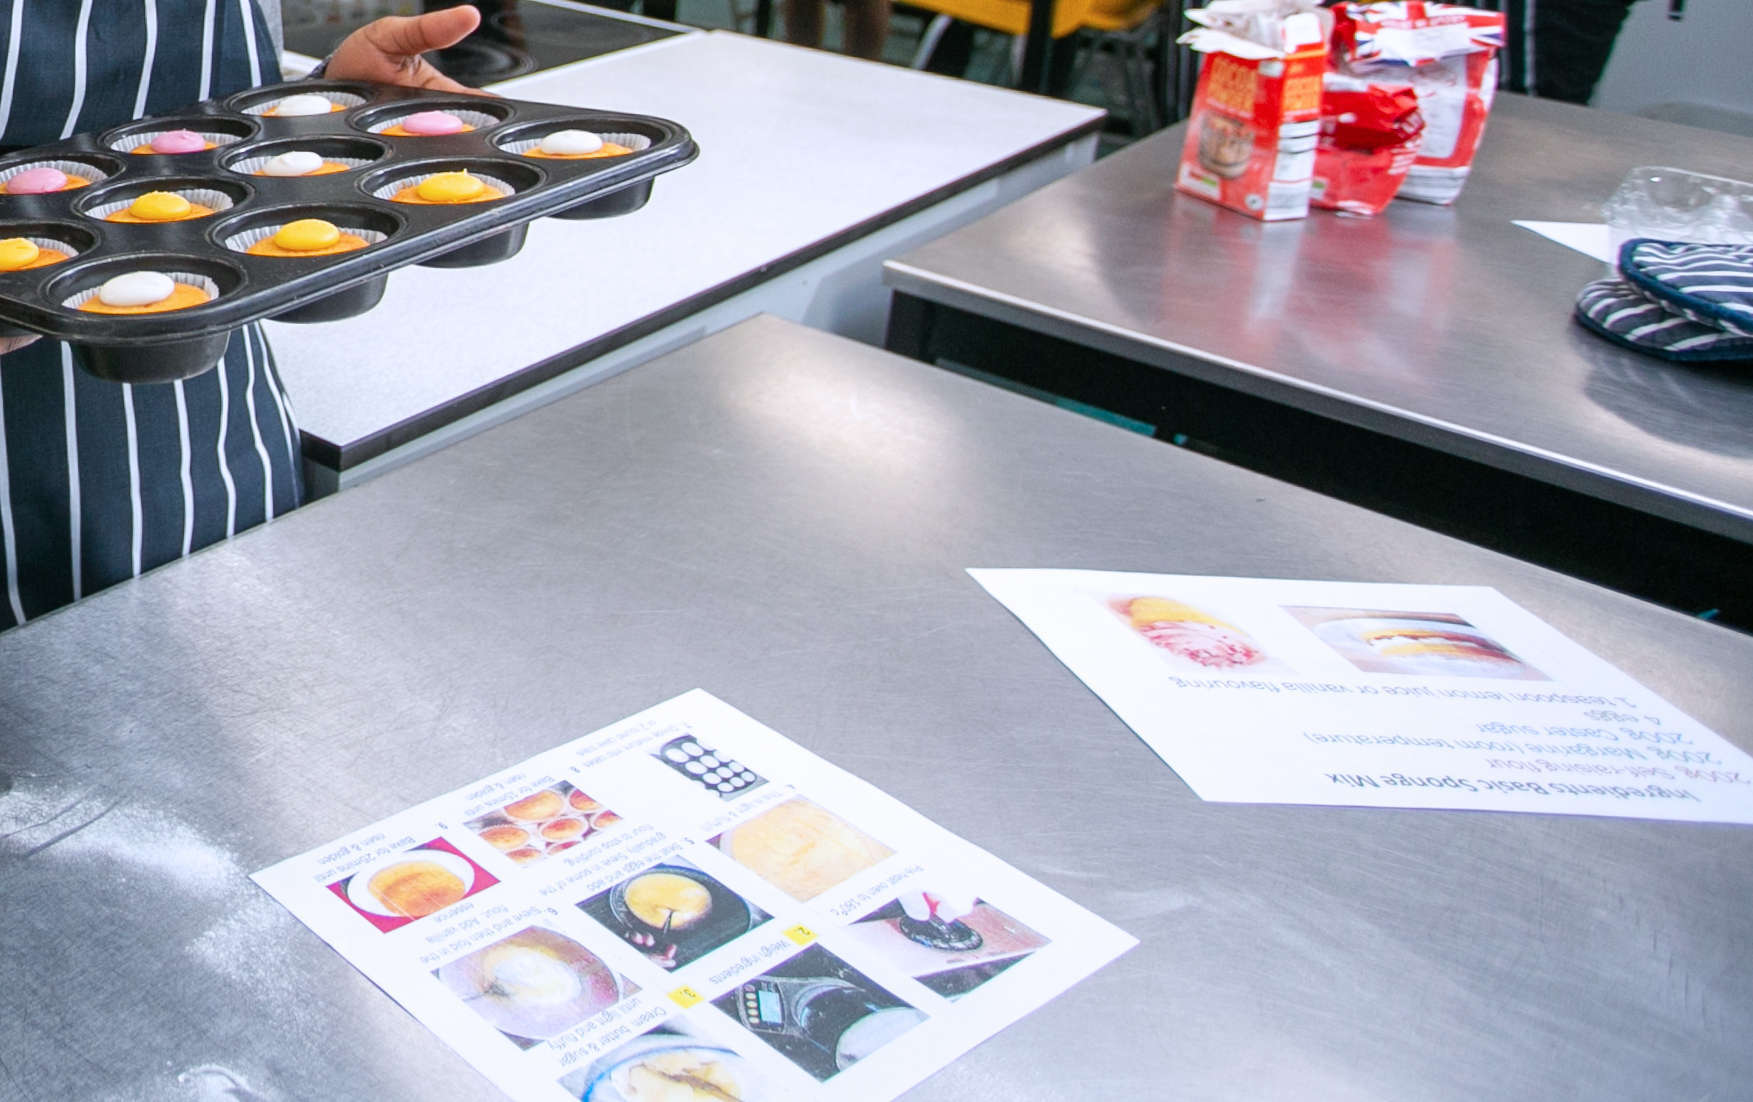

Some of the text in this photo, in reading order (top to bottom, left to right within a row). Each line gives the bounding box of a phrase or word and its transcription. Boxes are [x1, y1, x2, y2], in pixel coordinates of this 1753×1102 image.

[1168, 676, 1636, 709] 1 teaspoon lemon juice or vanilla flavouring
[1583, 710, 1661, 726] 4 eggs
[1475, 722, 1693, 745] 200g Caster sugar
[1303, 731, 1722, 765] 200g Margarine (room temperature)
[1485, 758, 1751, 784] 200g Self-raising flour
[502, 773, 526, 785] risen
[529, 775, 555, 789] Bake
[464, 784, 495, 801] golden
[1324, 773, 1701, 802] Ingredients Basic Sponge Mix
[484, 791, 519, 807] 15mins
[463, 804, 485, 818] until
[735, 803, 757, 814] light
[630, 824, 653, 838] flour
[359, 833, 386, 847] risen
[388, 836, 416, 850] Bake
[600, 837, 622, 851] stop
[316, 846, 351, 866] golden
[374, 846, 391, 857] for
[563, 846, 599, 868] curdling
[658, 843, 683, 856] Beat
[336, 853, 376, 873] 25mins
[601, 852, 628, 868] Sieve
[643, 852, 662, 864] the
[622, 860, 646, 874] eggs
[313, 869, 337, 883] until
[565, 868, 593, 884] some
[604, 870, 624, 882] and
[538, 885, 558, 898] the
[555, 880, 567, 891] of
[586, 879, 606, 892] add
[865, 882, 888, 896] oven
[512, 906, 542, 923] Sieve
[458, 917, 480, 931] Add
[492, 918, 514, 933] and
[425, 925, 459, 944] vanilla
[470, 928, 495, 942] then
[449, 937, 472, 952] fold
[758, 940, 791, 959] Weigh
[419, 952, 440, 965] the
[708, 957, 761, 985] ingredients
[547, 997, 643, 1051] until light and fluffy
[630, 1006, 667, 1027] Cream
[597, 1025, 632, 1046] butter
[558, 1048, 589, 1068] sugar
